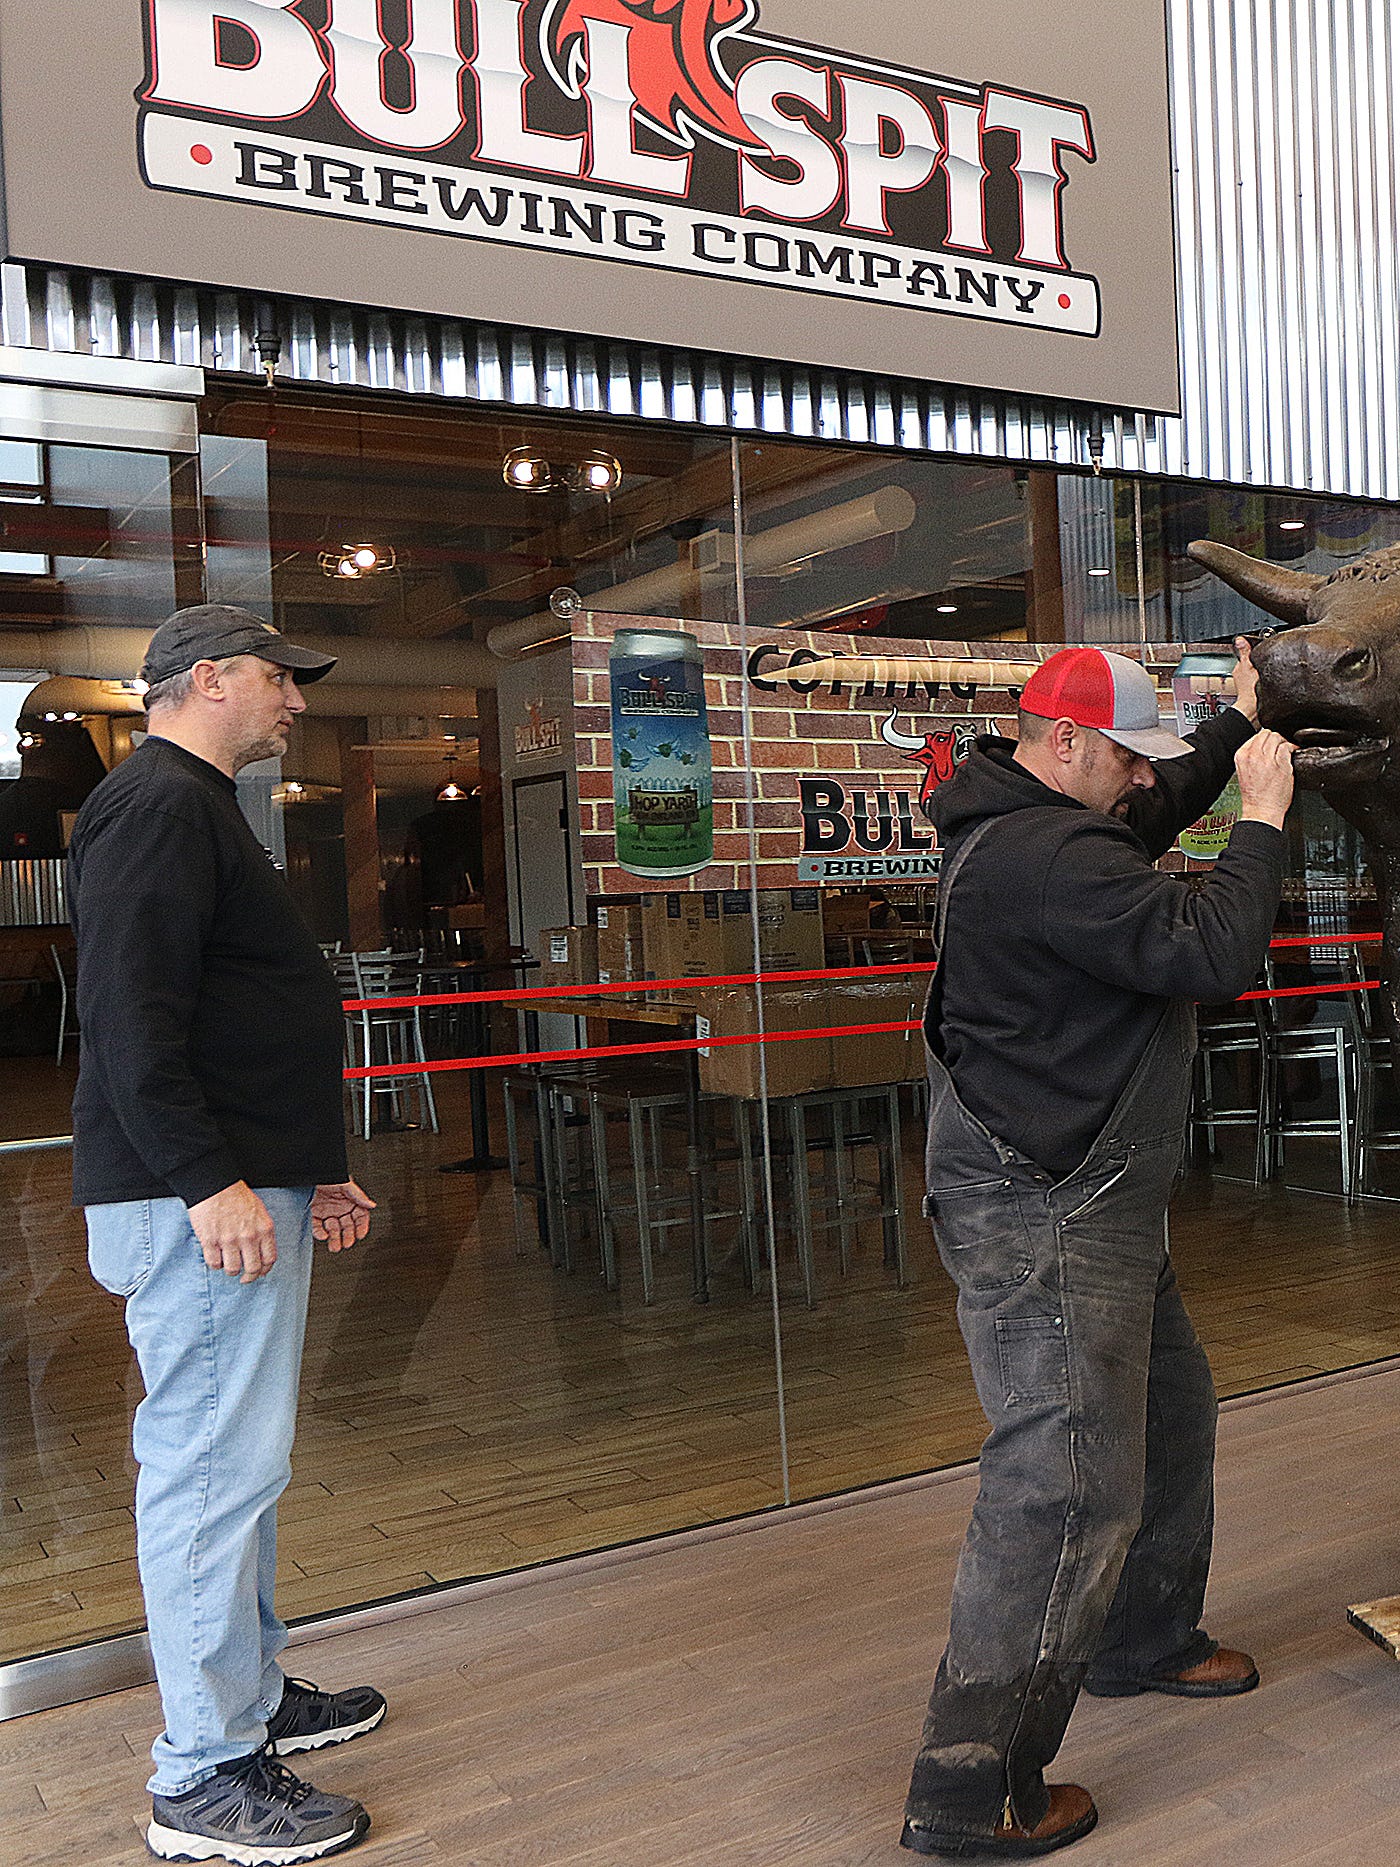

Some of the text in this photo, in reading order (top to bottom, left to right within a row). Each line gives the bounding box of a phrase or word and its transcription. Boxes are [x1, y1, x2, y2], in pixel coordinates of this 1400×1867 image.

[141, 0, 1095, 270] BULL SPIT
[235, 142, 1045, 313] BREWING COMPANY
[748, 644, 977, 700] COMING
[1183, 702, 1215, 719] BULL
[796, 777, 945, 853] BUL
[823, 857, 941, 877] BREWIN
